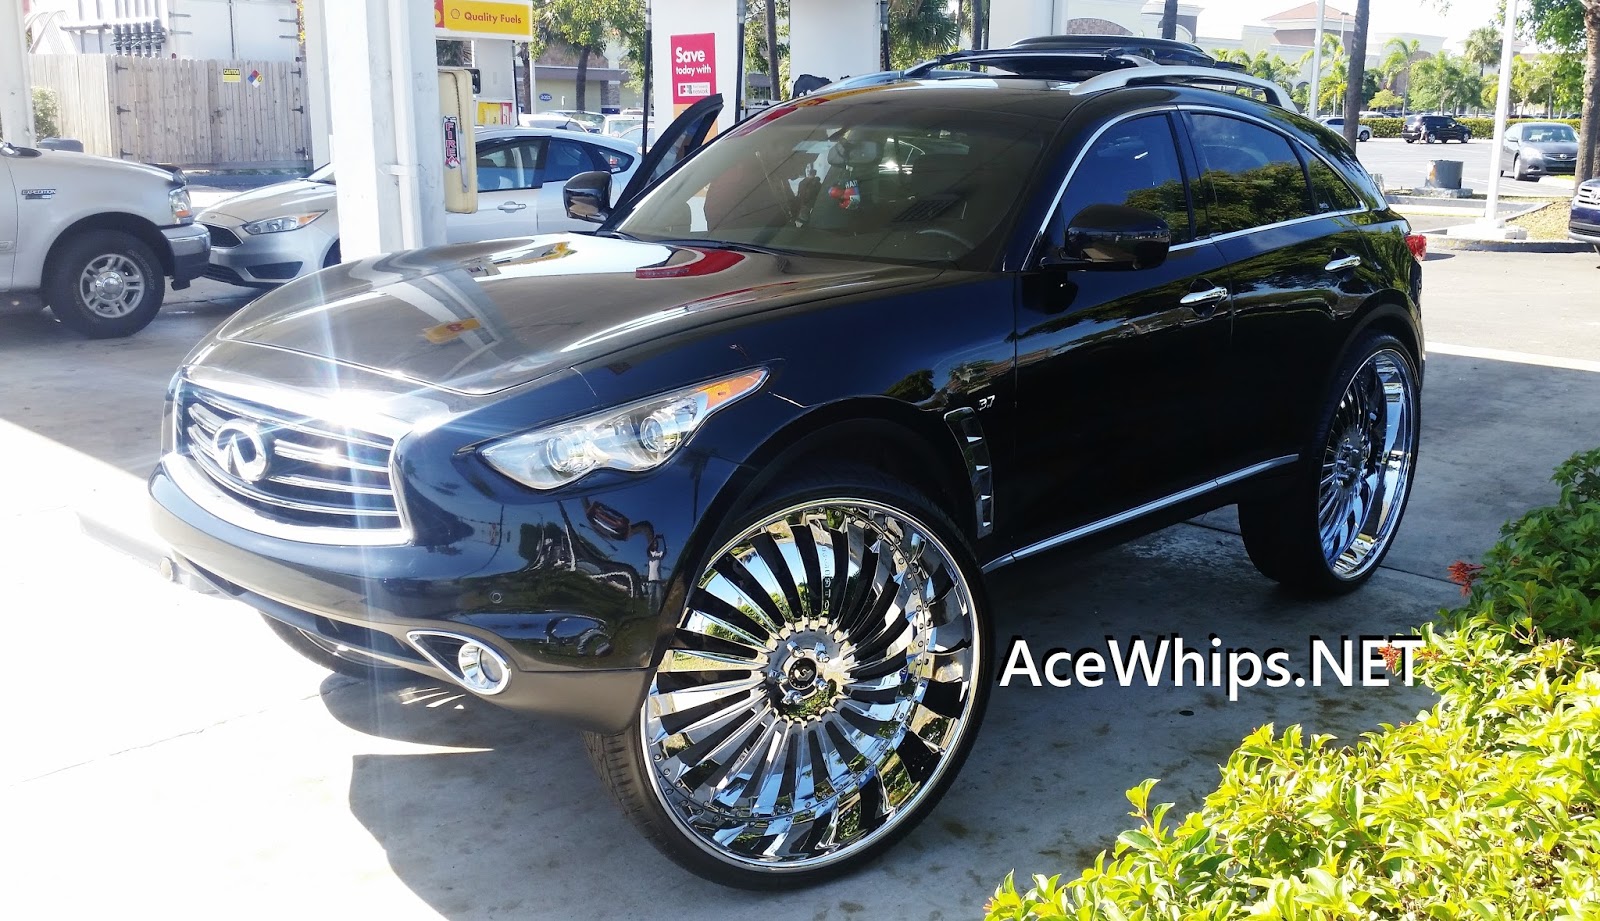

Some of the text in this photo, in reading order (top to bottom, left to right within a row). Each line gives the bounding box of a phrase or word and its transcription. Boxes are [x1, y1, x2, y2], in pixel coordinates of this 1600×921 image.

[464, 12, 522, 24] Quality Fuels
[675, 46, 706, 63] Save
[675, 63, 712, 77] today with
[445, 122, 457, 157] FIRE
